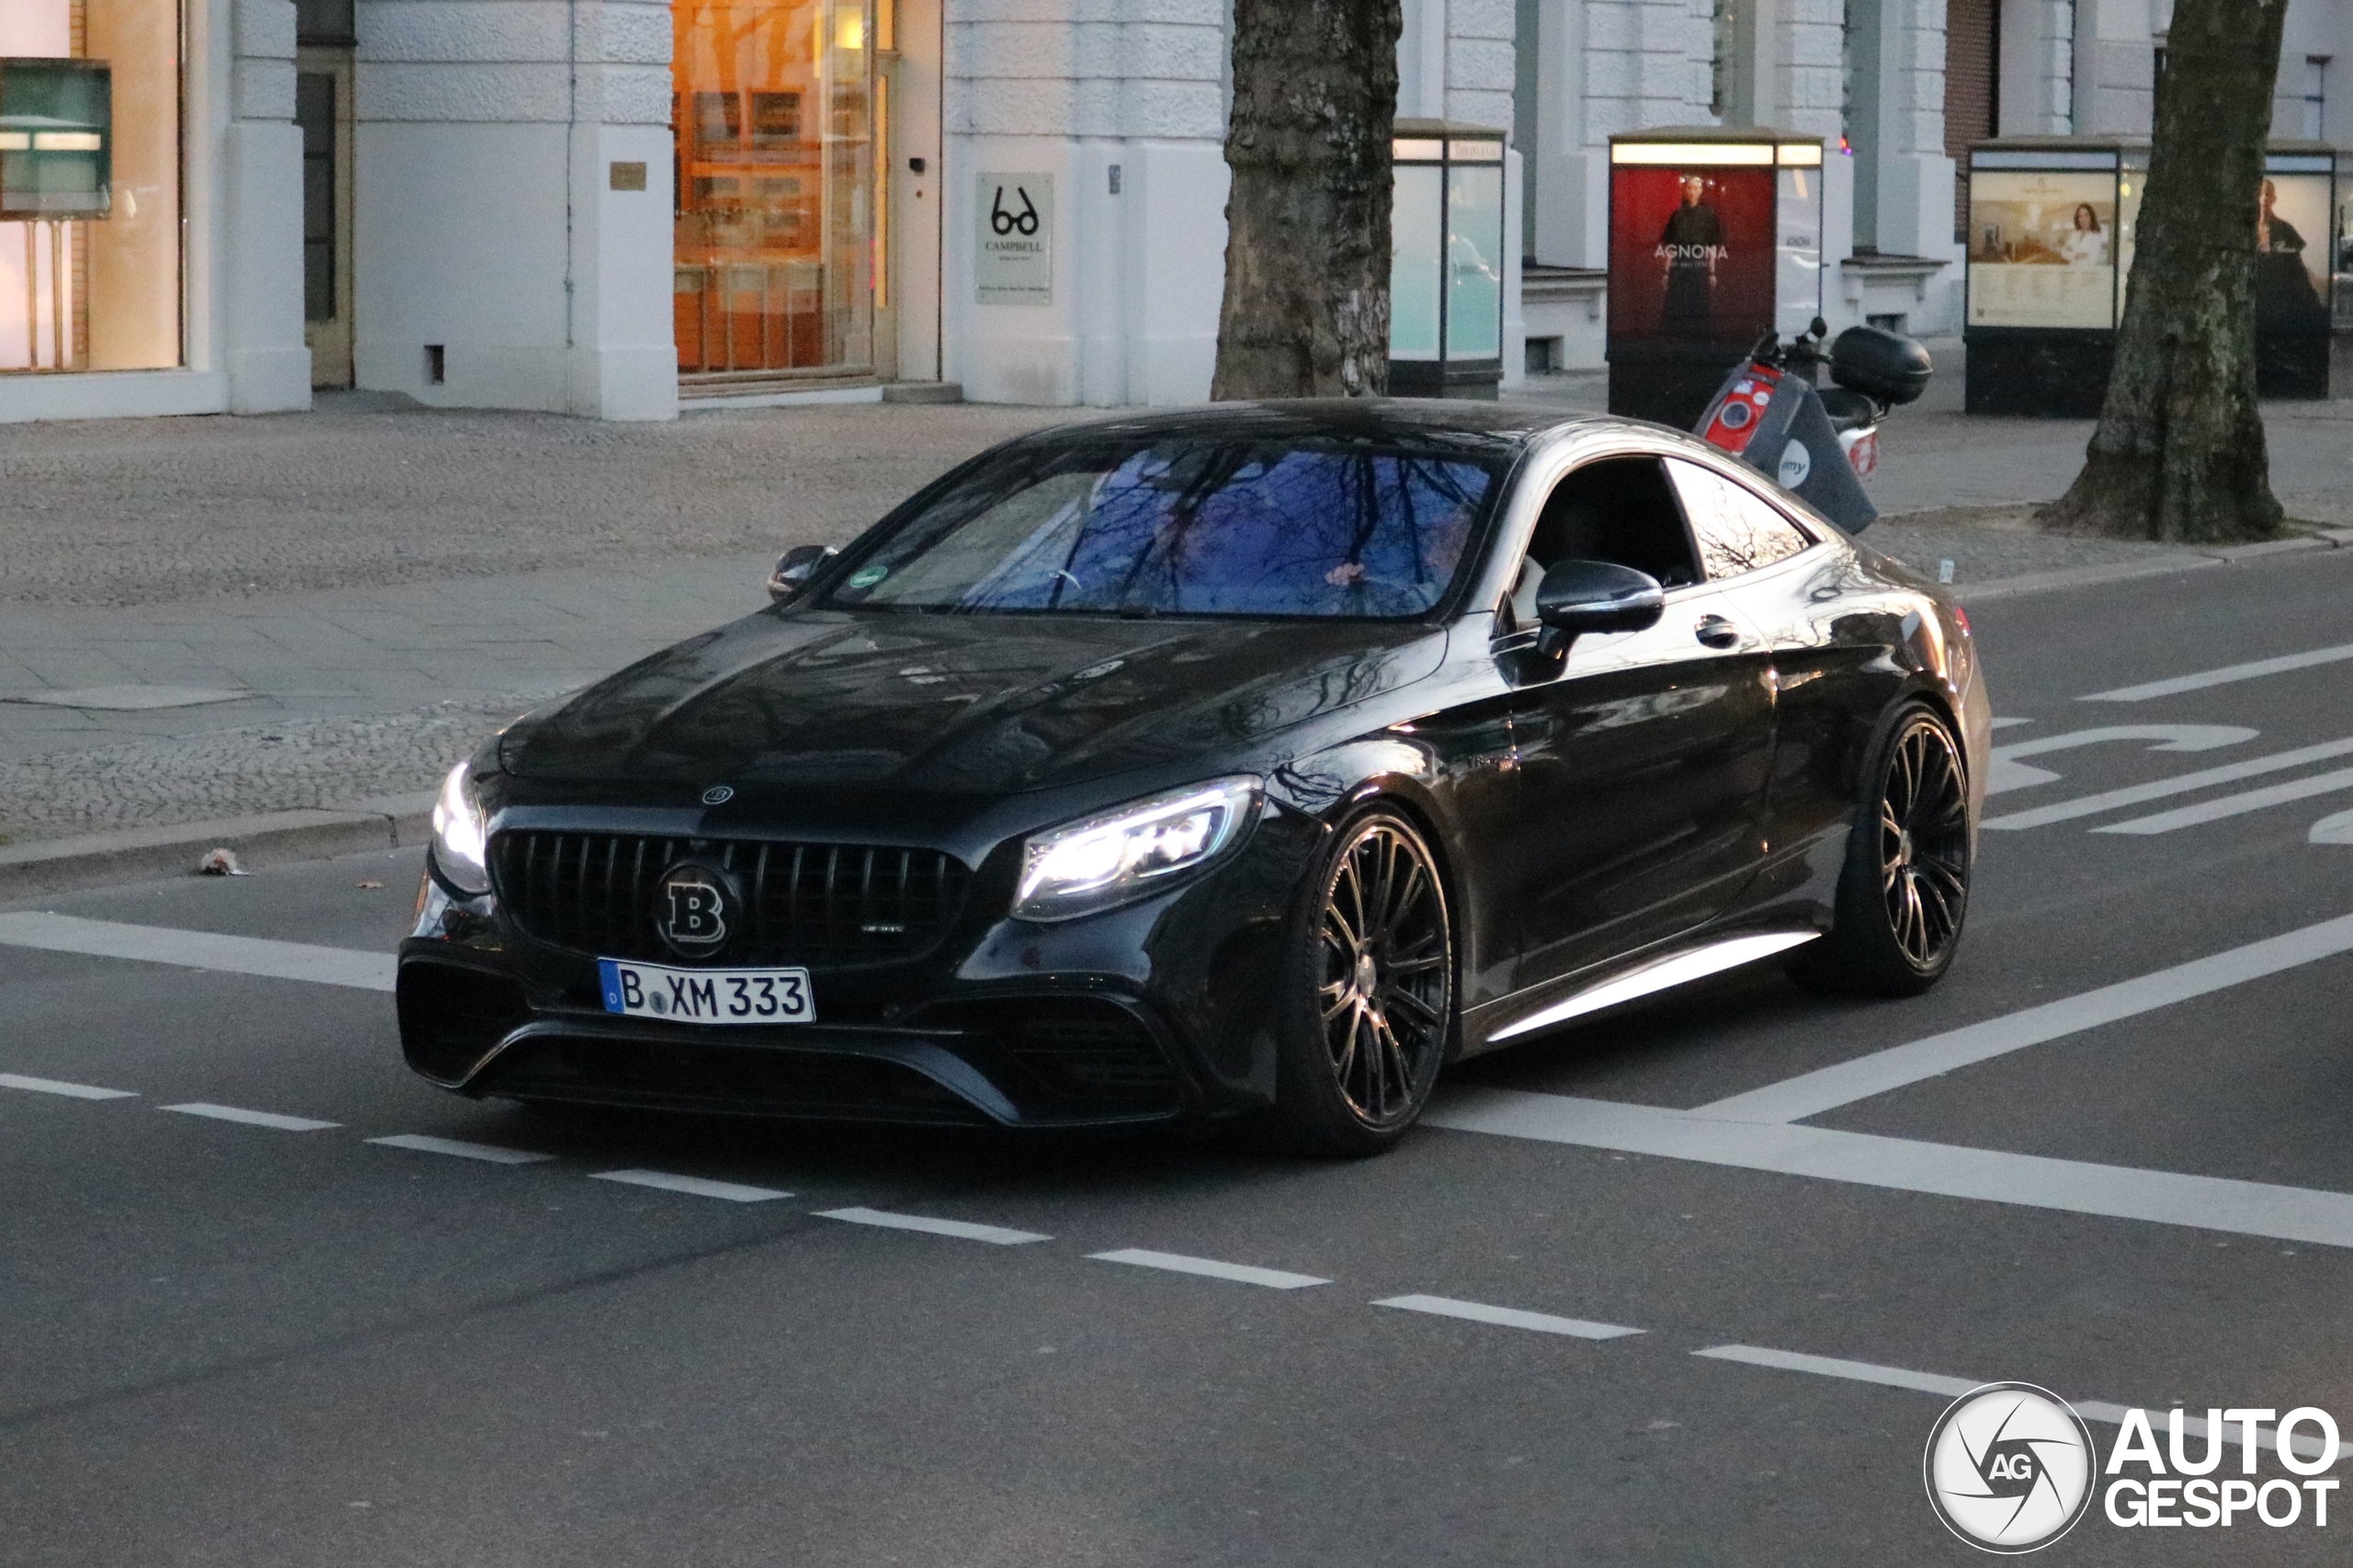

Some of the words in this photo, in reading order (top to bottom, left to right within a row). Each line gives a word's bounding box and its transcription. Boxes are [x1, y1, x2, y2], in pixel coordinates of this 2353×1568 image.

[985, 242, 1042, 252] CAMPBELL
[668, 881, 726, 943] B
[609, 993, 617, 1004] D
[620, 969, 645, 1009] B
[666, 975, 719, 1017] XM
[726, 977, 804, 1017] 333
